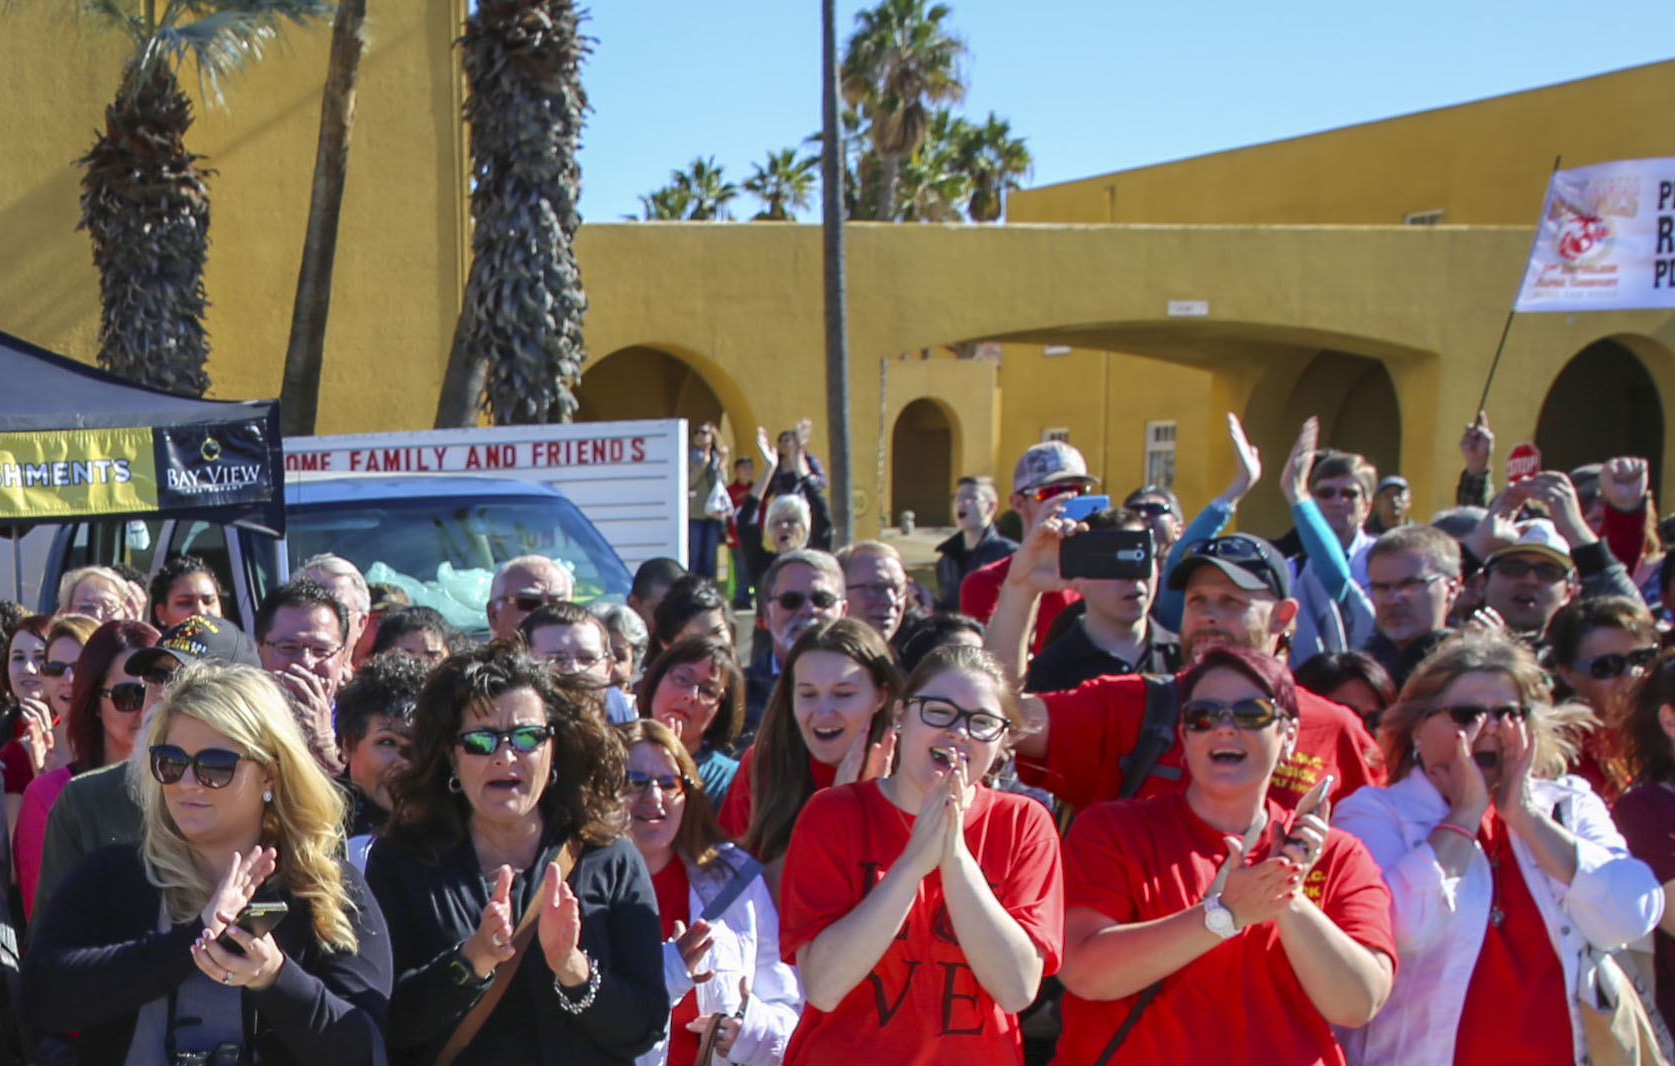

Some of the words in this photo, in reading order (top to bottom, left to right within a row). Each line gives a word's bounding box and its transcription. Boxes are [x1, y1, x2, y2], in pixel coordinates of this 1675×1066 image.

[349, 446, 448, 471] FAMILY
[466, 444, 517, 469] AND
[532, 437, 646, 467] FRIENDS
[1508, 456, 1538, 475] STOP
[167, 468, 200, 487] BAY
[206, 464, 261, 484] VIEW
